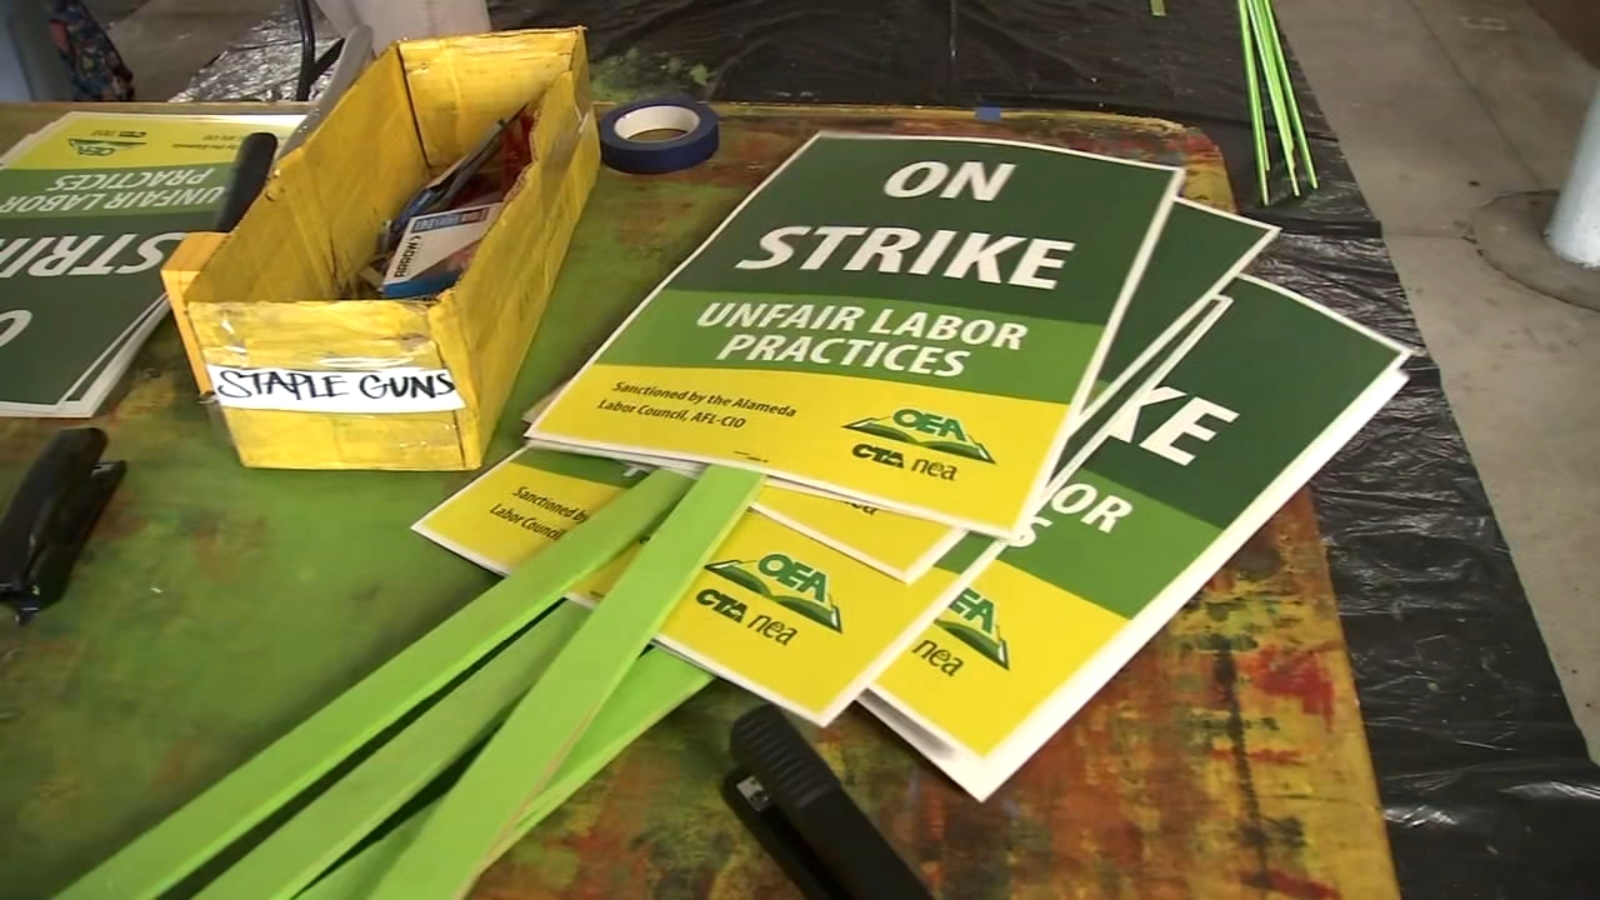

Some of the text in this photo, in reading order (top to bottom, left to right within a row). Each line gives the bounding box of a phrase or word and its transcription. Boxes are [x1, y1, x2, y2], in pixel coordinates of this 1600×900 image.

[45, 166, 216, 192] PRACTICES
[883, 160, 1017, 202] ON
[0, 185, 227, 213] UNFAIR LABOR
[0, 231, 187, 279] STRI
[735, 225, 1076, 291] STRIKE
[696, 301, 1029, 351] UNFAIR LABOR
[715, 333, 971, 378] PRACTICES
[217, 370, 456, 401] STAPLE GUNS
[612, 381, 797, 418] Sanctioned by the Alameda
[597, 399, 747, 429] Labor Council, AFL-CIO
[893, 409, 966, 441] OEA
[852, 443, 958, 481] CTA nea
[489, 503, 524, 525] Labor
[513, 486, 589, 525] Sanctioned by
[758, 553, 827, 603] OEA
[695, 588, 798, 646] CTA nea
[911, 639, 964, 677] nea
